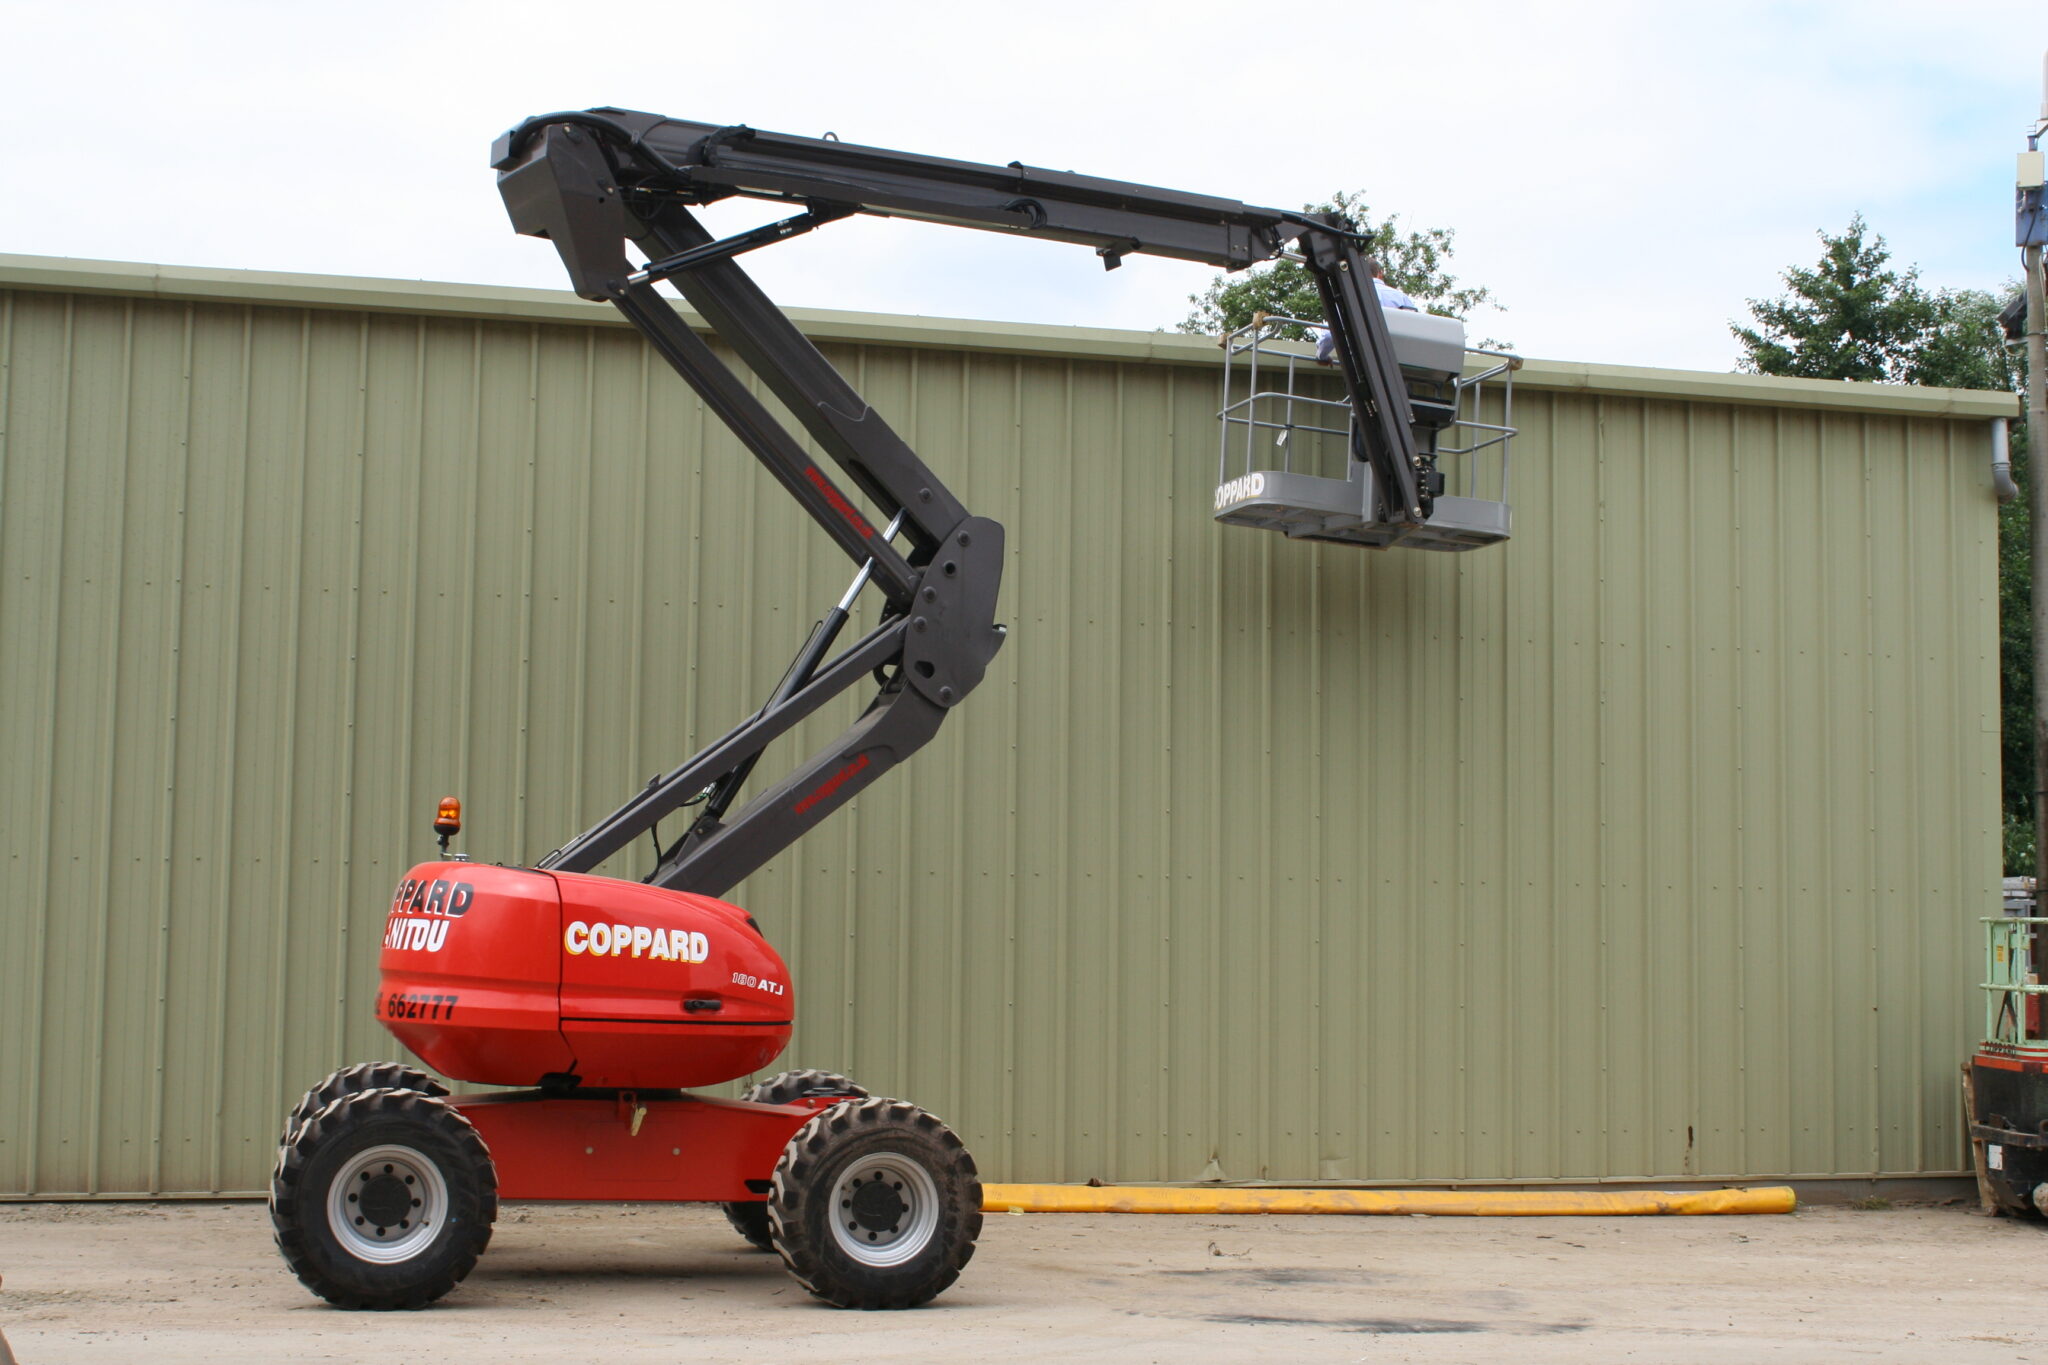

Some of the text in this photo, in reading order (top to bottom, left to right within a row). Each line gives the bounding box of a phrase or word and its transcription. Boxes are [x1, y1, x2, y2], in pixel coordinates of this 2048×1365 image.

[388, 878, 475, 918] PPARD
[564, 920, 709, 964] COPPARD
[757, 978, 784, 996] ATJ
[388, 993, 459, 1020] 662777
